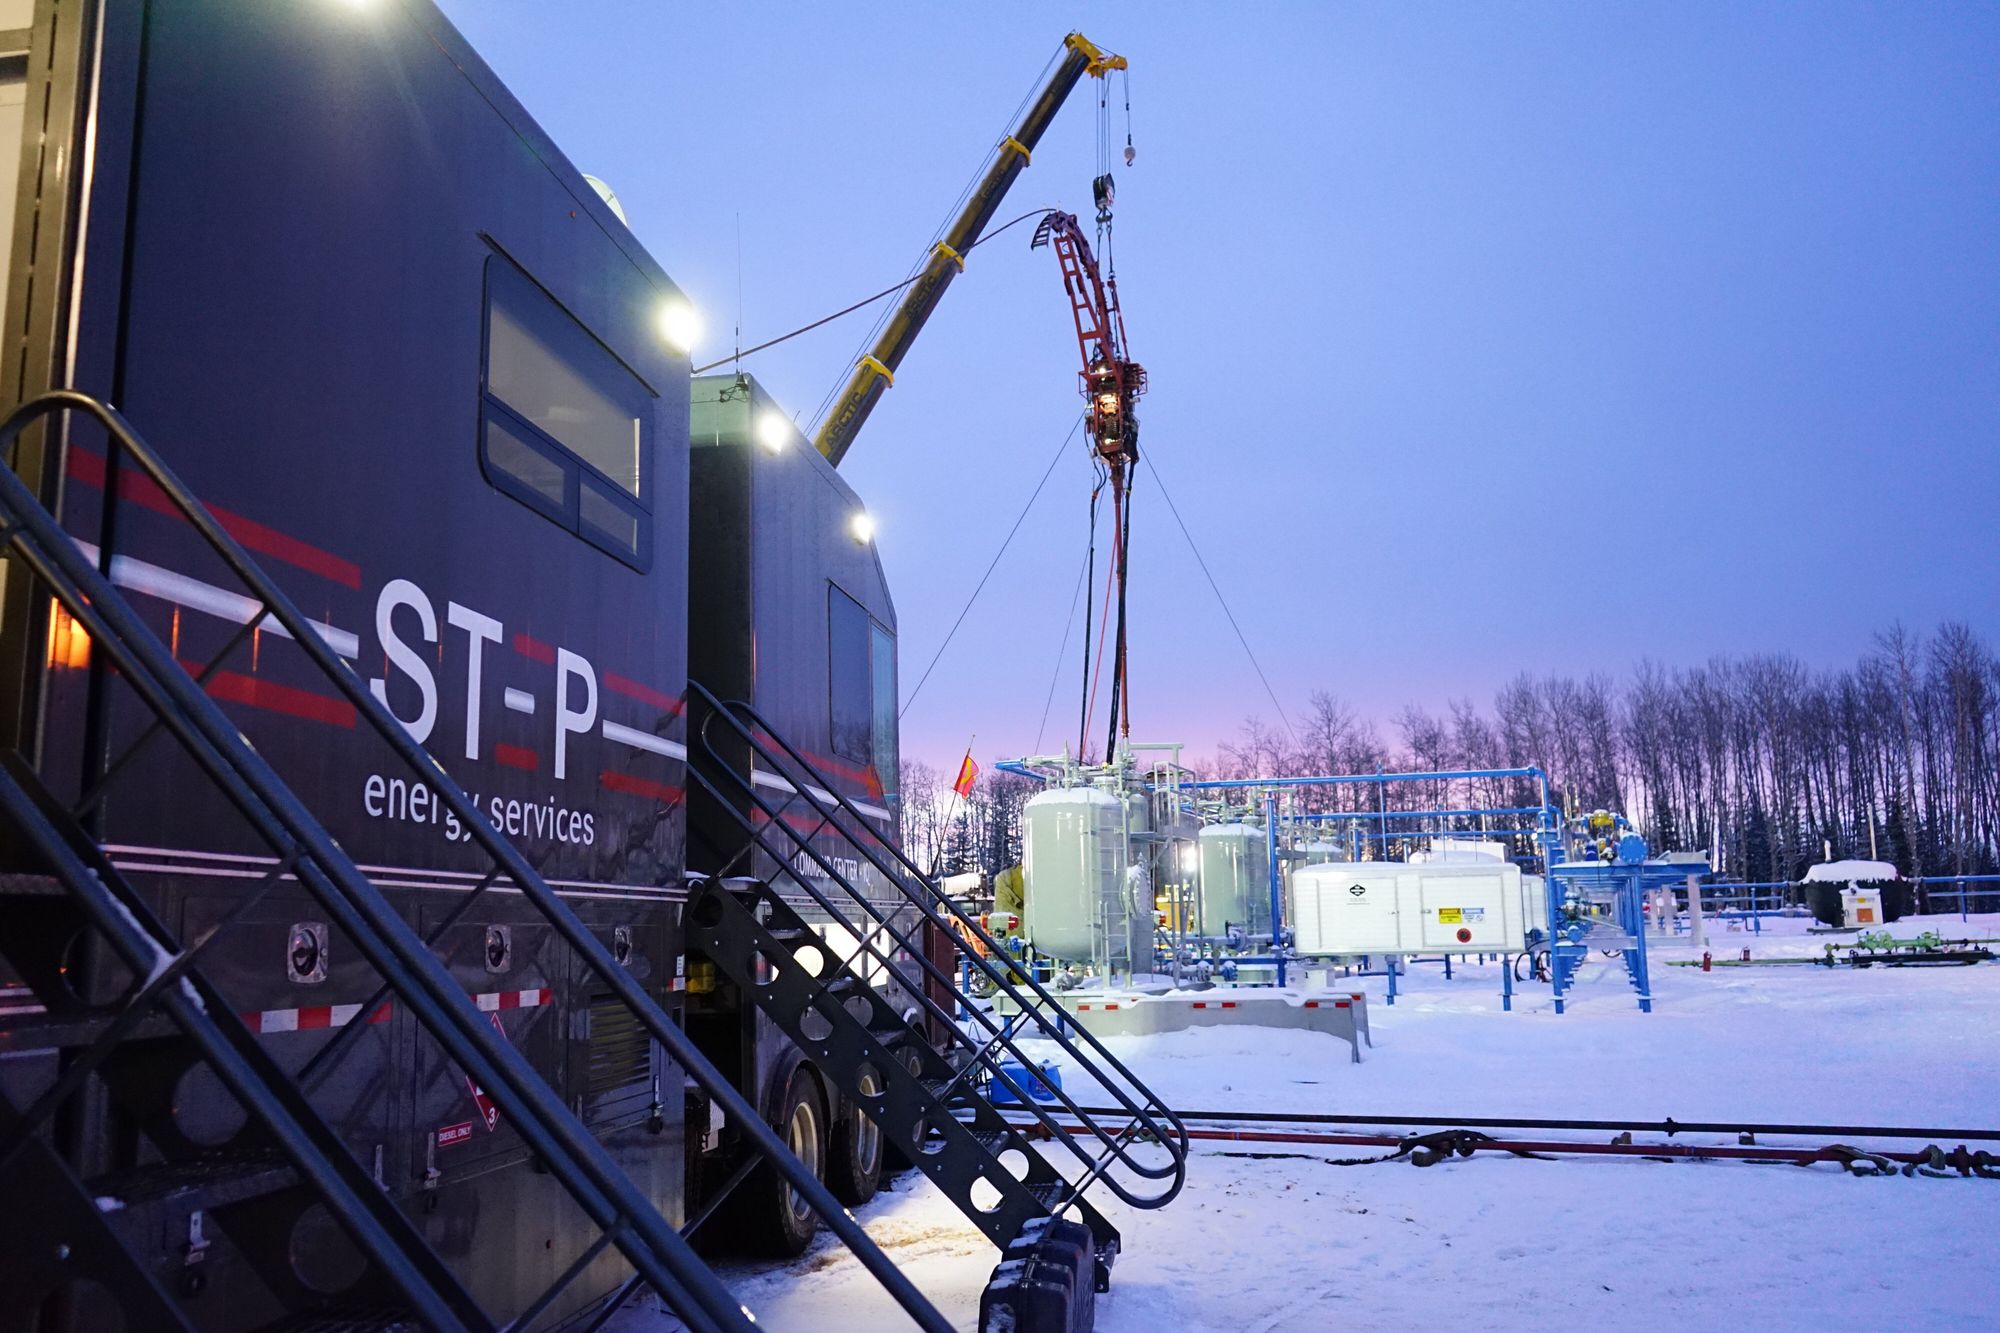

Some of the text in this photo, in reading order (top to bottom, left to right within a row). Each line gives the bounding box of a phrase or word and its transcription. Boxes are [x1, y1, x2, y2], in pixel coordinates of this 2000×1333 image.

[824, 391, 864, 447] ARCTIC
[490, 795, 594, 846] services
[833, 857, 858, 881] CENTER
[488, 1107, 496, 1124] 3
[439, 1126, 472, 1142] DIESEL ONLY
